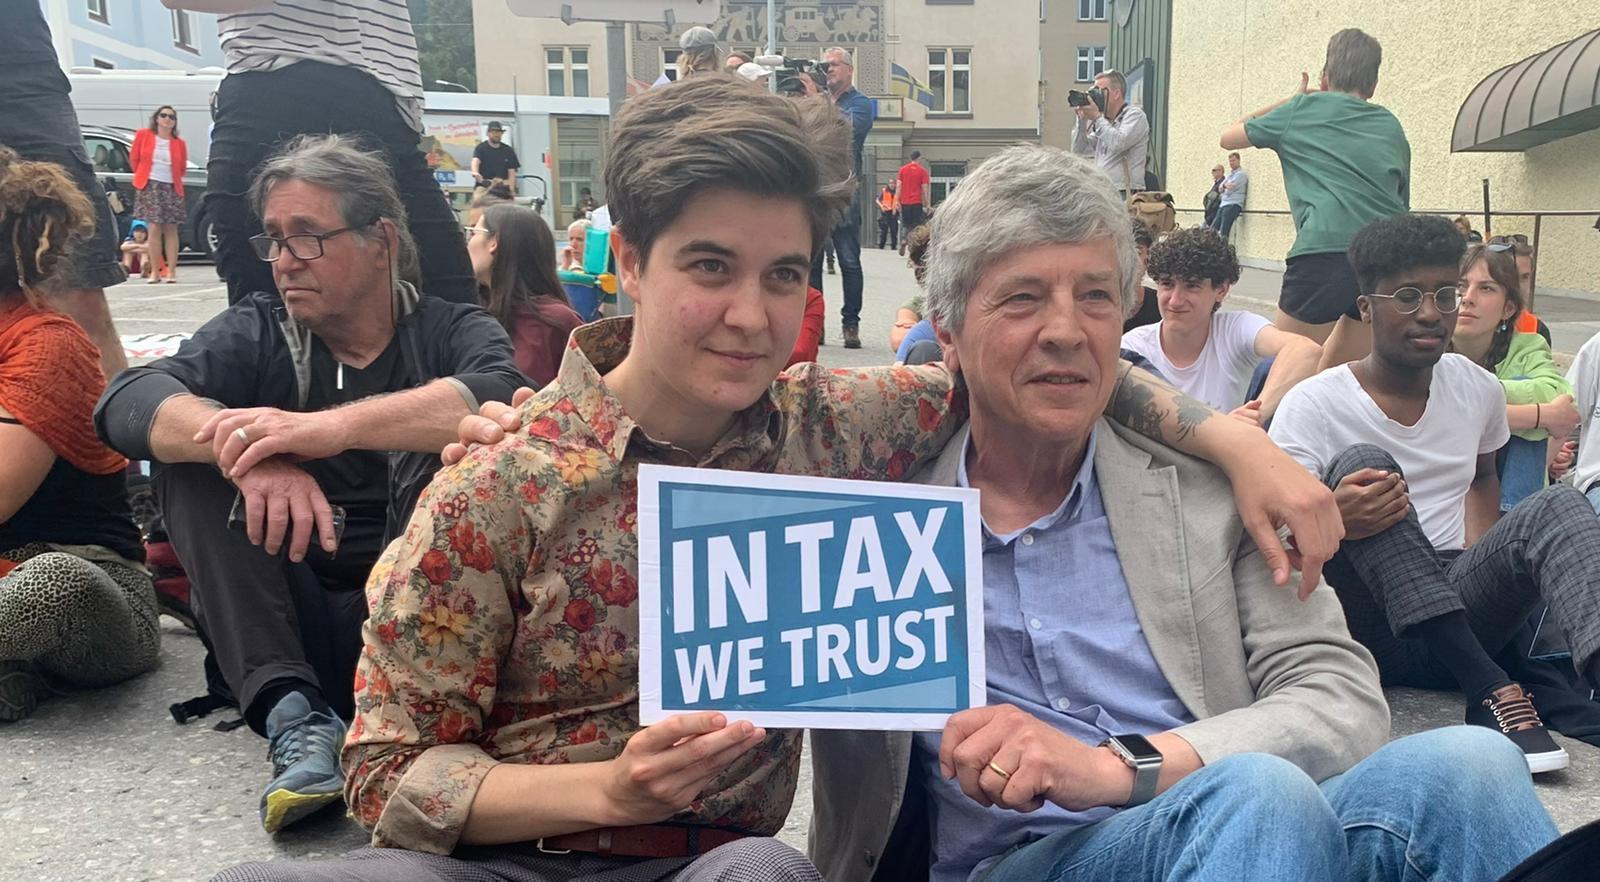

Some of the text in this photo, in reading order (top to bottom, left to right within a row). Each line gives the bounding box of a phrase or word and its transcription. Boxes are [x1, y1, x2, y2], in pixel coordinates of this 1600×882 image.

[672, 507, 953, 634] IN TAX
[674, 605, 955, 705] WE TRUST
